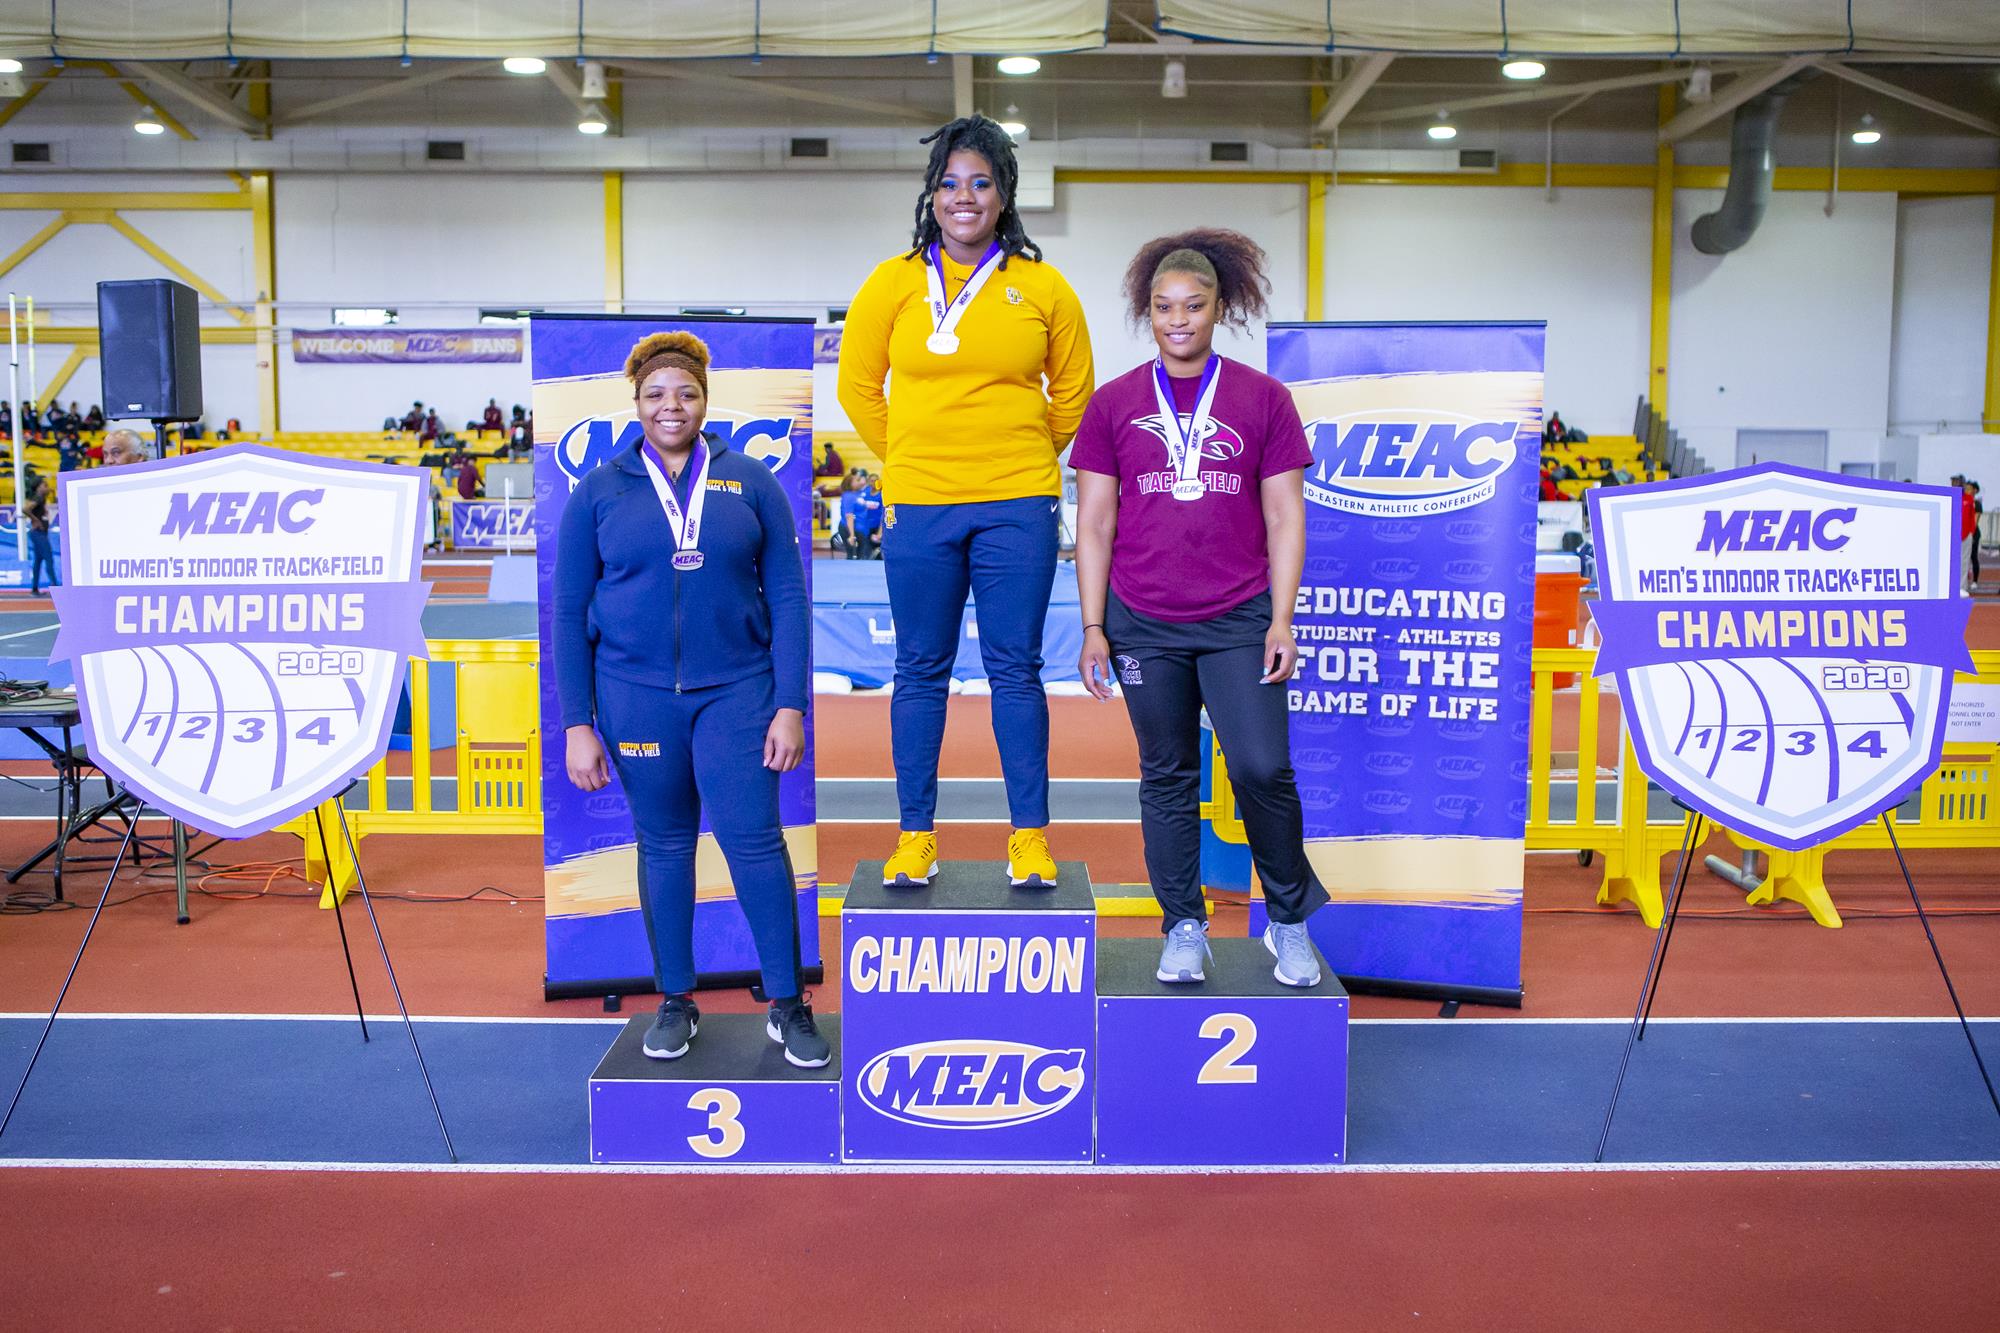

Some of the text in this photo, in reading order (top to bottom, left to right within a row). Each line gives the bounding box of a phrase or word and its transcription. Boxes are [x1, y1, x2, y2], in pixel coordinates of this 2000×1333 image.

[300, 335, 517, 353] WELCOME MEAC FANS
[1175, 443, 1184, 465] MEA
[1309, 421, 1518, 484] MEAC
[1175, 485, 1203, 494] MEAC
[1201, 471, 1241, 494] FIELD
[1305, 486, 1365, 511] ID-EASTERN
[1370, 504, 1418, 513] ATHLETIC
[1424, 485, 1492, 511] CONFERENCE
[160, 489, 325, 541] MEAC
[462, 505, 536, 544] MEA
[687, 518, 696, 540] MEAC
[1695, 507, 1857, 558] MEAC
[99, 556, 383, 578] WOMEN'S INDOOR TRACK&FIELD
[674, 554, 703, 566] MEAC
[1639, 566, 1920, 593] MEN'S INDOOR TRACK&FIELD
[115, 593, 365, 634] CHAMPIONS
[1294, 586, 1505, 620] EDUCATING
[1290, 625, 1376, 642] STUDENT
[1398, 629, 1500, 647] ATHLETES
[1657, 609, 1907, 648] CHAMPIONS
[278, 651, 363, 676] 2020
[1291, 646, 1499, 688] FOR THE
[1823, 666, 1909, 690] 2020
[1288, 690, 1498, 720] GAME OF LIFE
[144, 715, 336, 745] 1 2 3 4
[1695, 728, 1888, 758] 1 2 3 4
[850, 936, 1086, 994] CHAMPION
[1197, 1013, 1257, 1084] 2
[877, 1048, 1086, 1112] MEAC
[686, 1088, 745, 1159] 3
